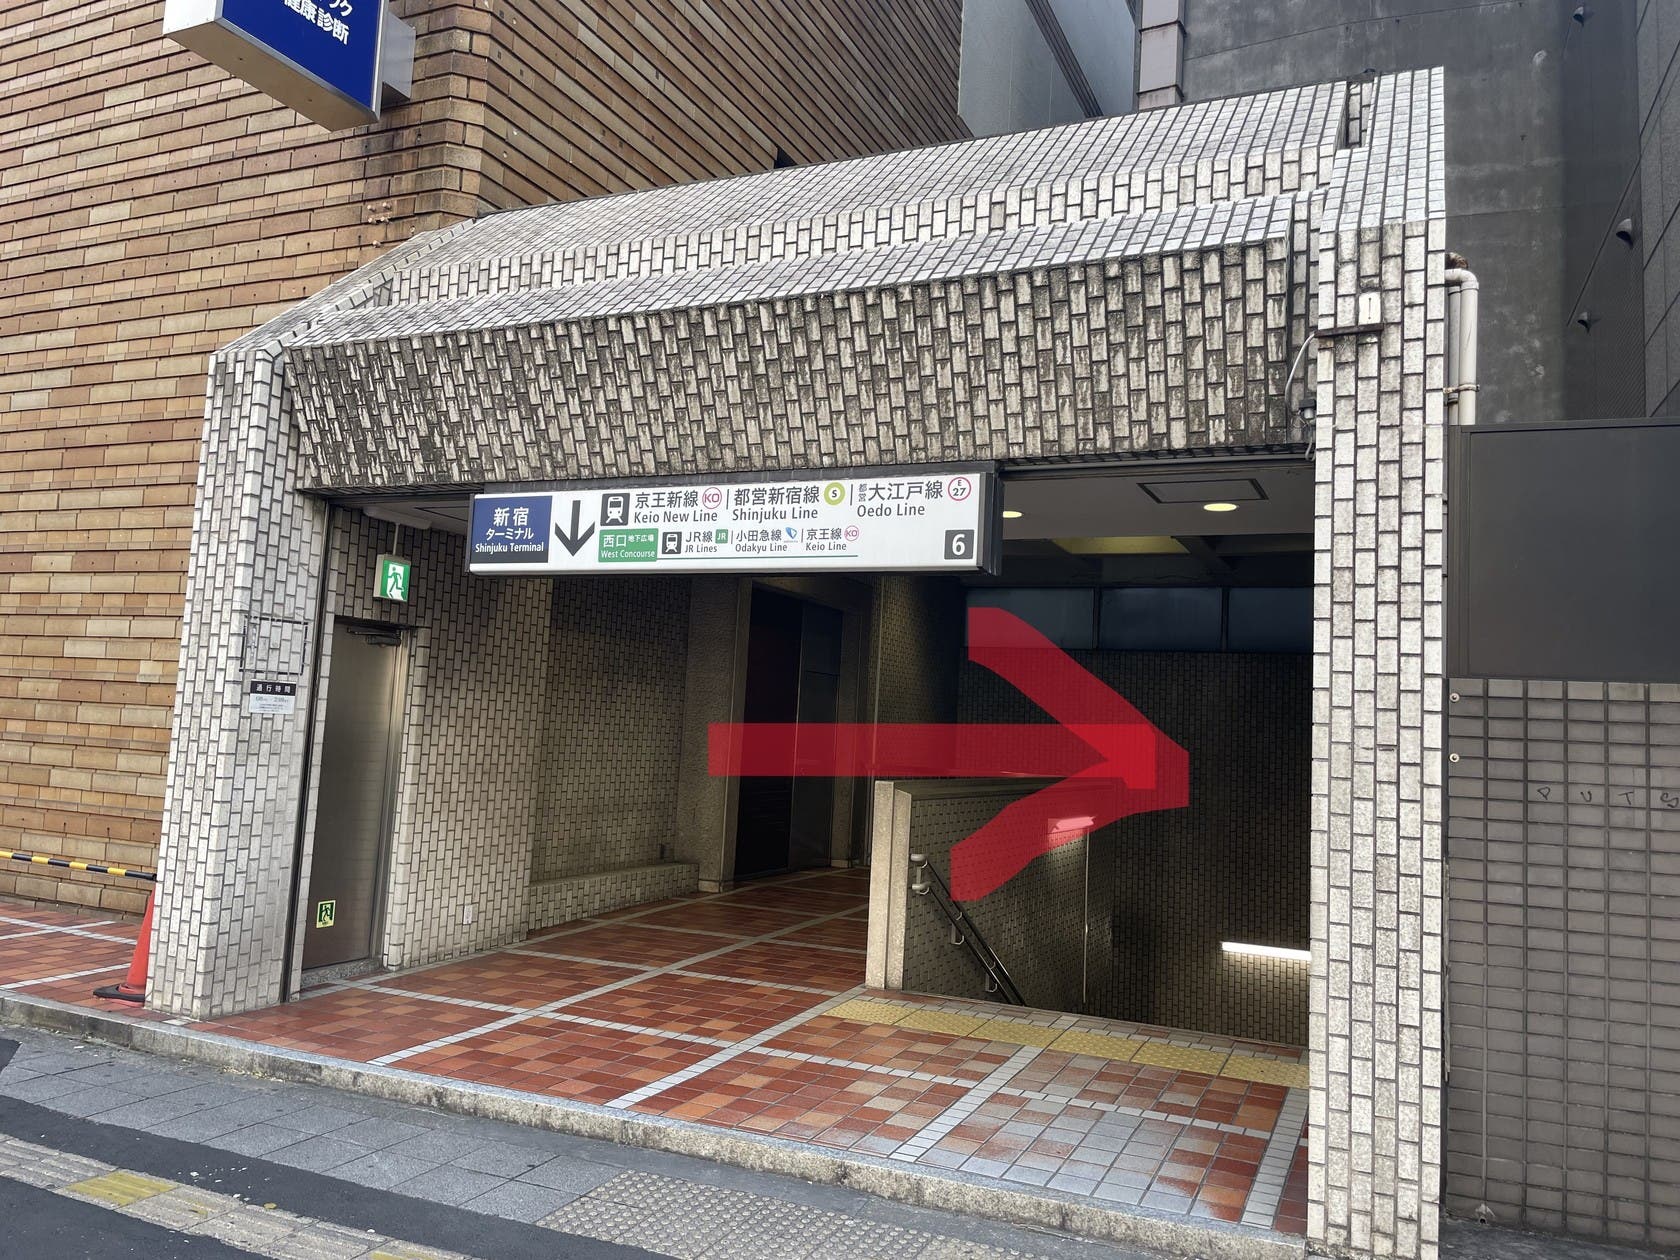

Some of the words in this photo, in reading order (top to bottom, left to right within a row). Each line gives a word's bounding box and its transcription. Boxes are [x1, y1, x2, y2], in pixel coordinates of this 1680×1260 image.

[734, 485, 820, 506] 都営新宿線
[868, 480, 943, 501] 大江戸線
[952, 488, 966, 497] 27
[635, 490, 699, 509] 京王新線
[493, 506, 529, 527] 新宿
[634, 511, 660, 523] Keio
[663, 511, 689, 523] New
[693, 509, 718, 522] Line
[732, 507, 787, 523] Shinjuku
[792, 506, 818, 519] Line
[857, 504, 892, 517] Oedo
[897, 503, 925, 516] Line
[486, 527, 534, 540] ターミナル
[685, 531, 713, 543] JR線
[736, 529, 782, 542] 小田急線
[806, 528, 842, 541] 京王線
[603, 534, 627, 547] 西口
[805, 542, 825, 551] Keio
[828, 541, 847, 551] Line
[952, 533, 966, 556] 6
[475, 543, 508, 555] Shinjuku
[510, 541, 544, 552] Terminal
[601, 550, 618, 558] West
[620, 549, 655, 558] Concourse
[685, 545, 694, 553] JR
[696, 544, 718, 553] Lines
[735, 543, 767, 554] Odakyu
[769, 542, 788, 552] Line
